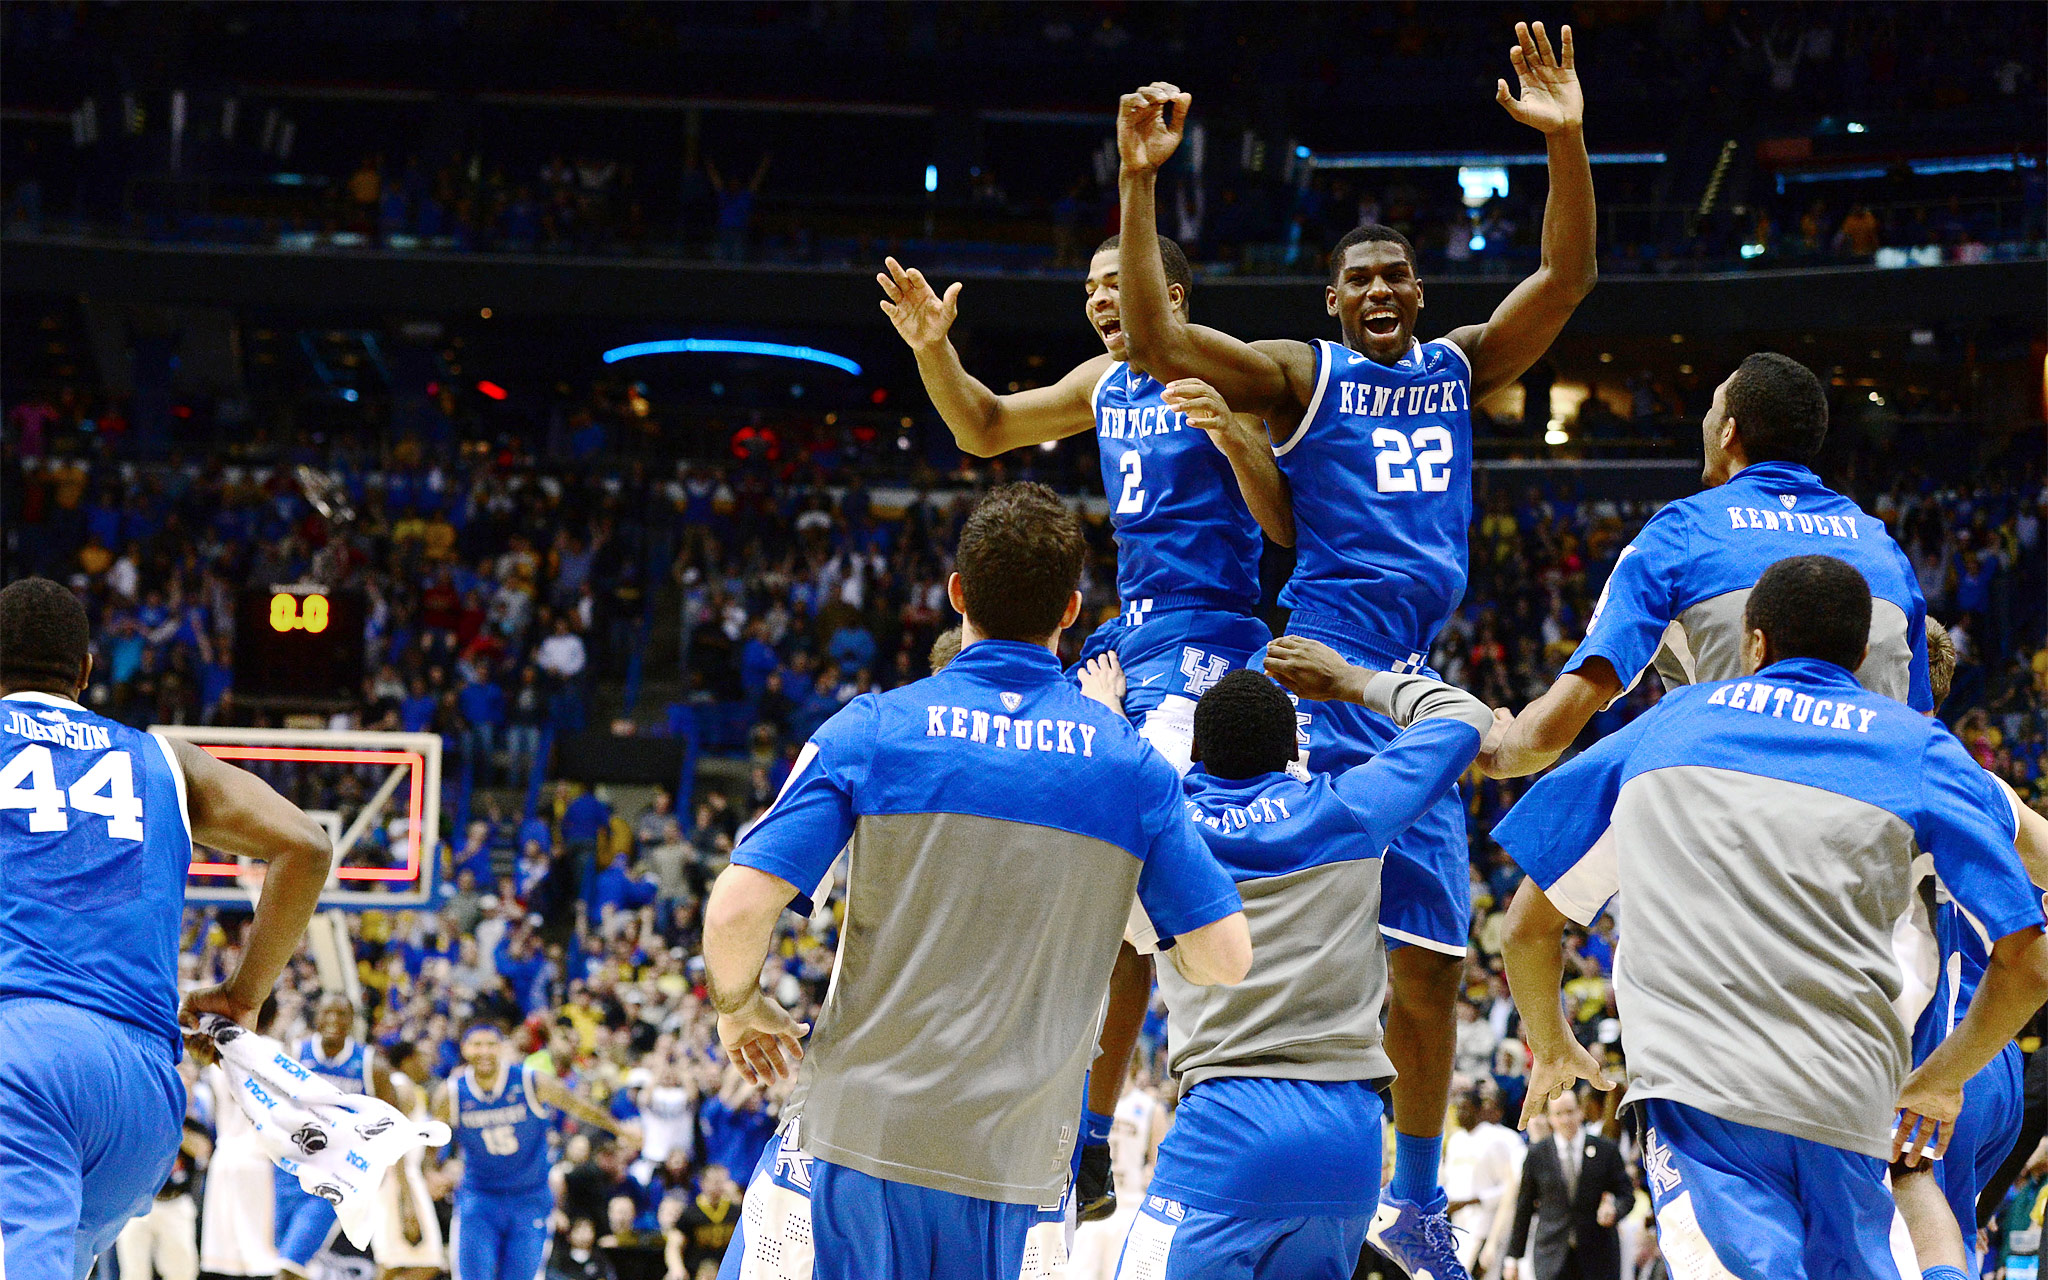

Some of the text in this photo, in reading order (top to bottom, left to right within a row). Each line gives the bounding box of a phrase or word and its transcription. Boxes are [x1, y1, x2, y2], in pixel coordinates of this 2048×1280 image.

[1339, 381, 1469, 417] KENTUCKY
[1115, 449, 1146, 514] 2
[1371, 425, 1454, 493] 22
[1727, 506, 1859, 539] KENTUCKY
[3, 711, 112, 751] JOHNSON
[926, 705, 1097, 758] KENTUCKY
[1707, 682, 1877, 733] KENTUCKY
[0, 743, 144, 842] 44
